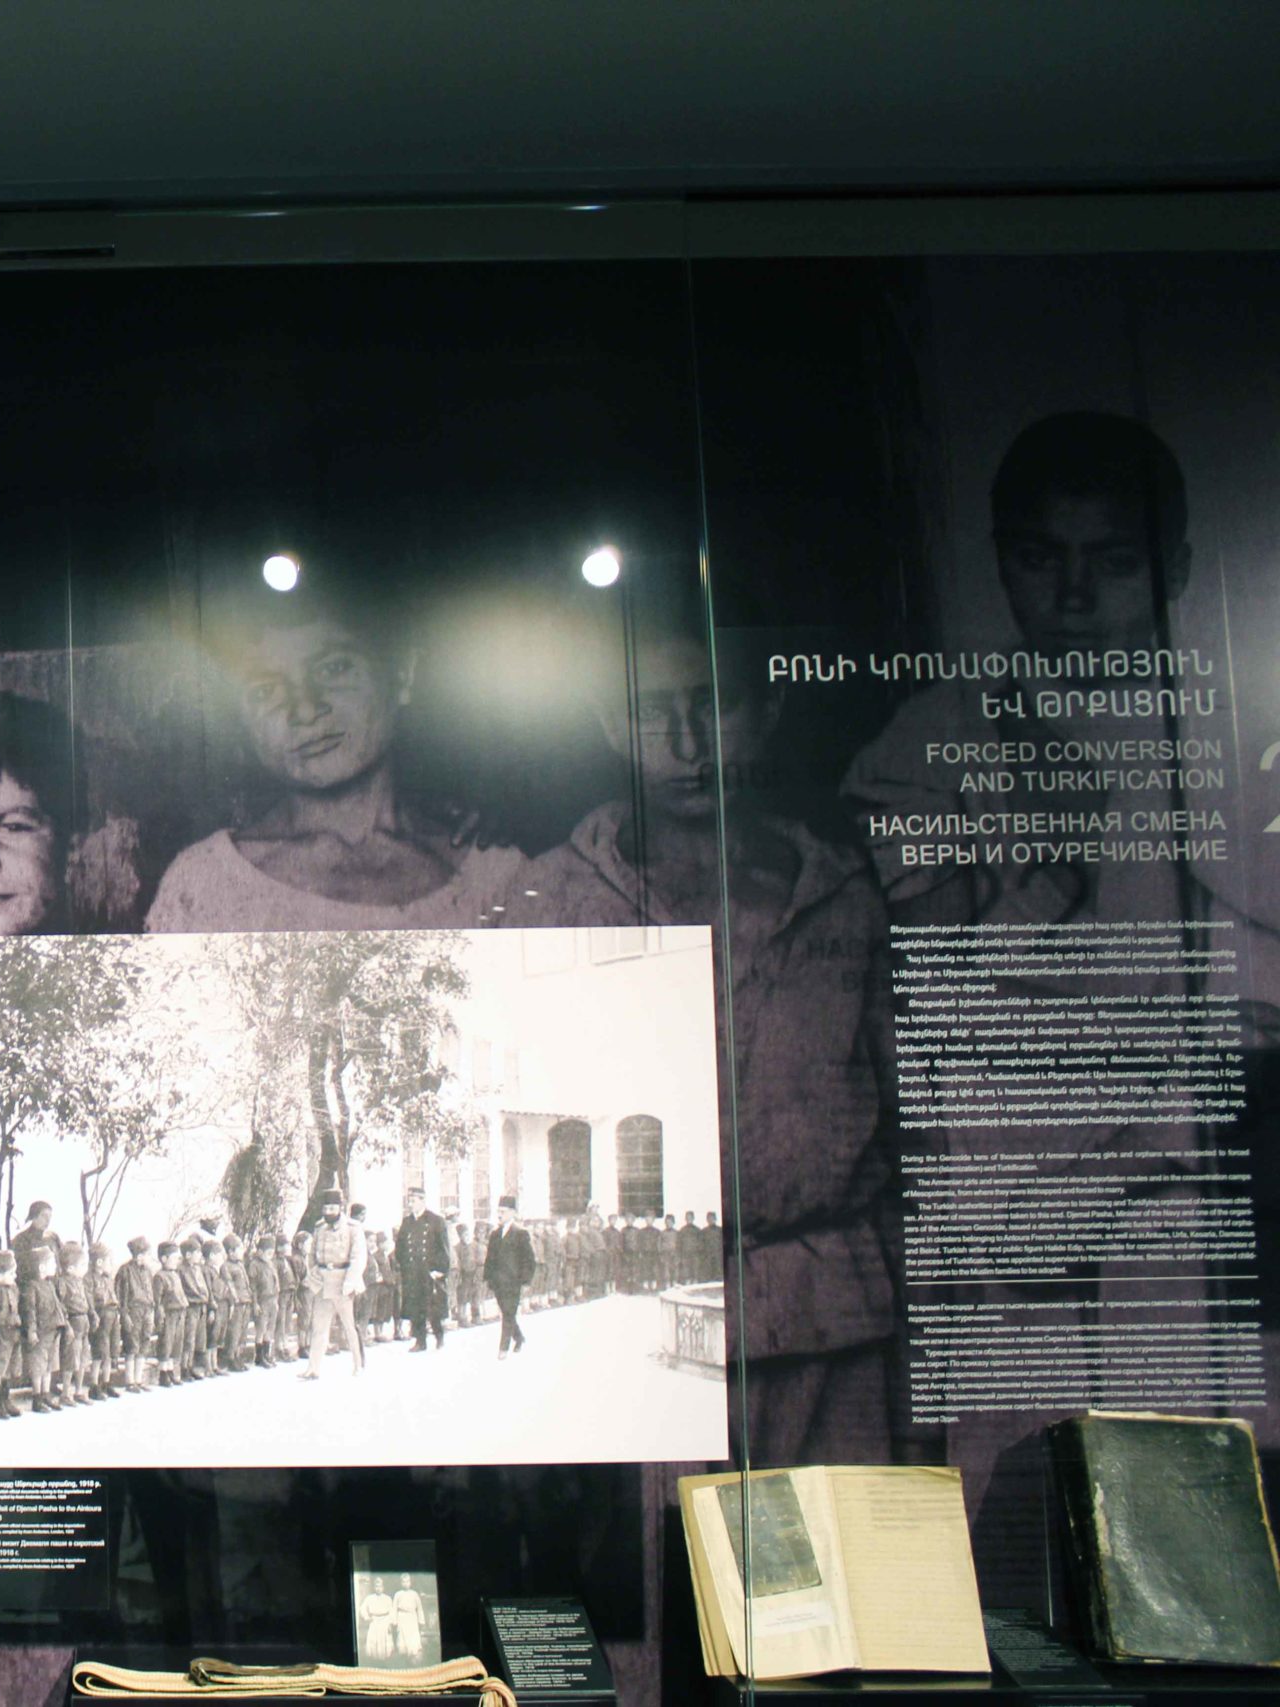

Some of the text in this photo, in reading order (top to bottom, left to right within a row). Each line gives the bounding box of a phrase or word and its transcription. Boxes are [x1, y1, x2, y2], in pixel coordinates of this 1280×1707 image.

[768, 648, 1213, 682] ԲՌՆԻ ԿՐՈՆԱՓՈԽՈՒԹՅՈՒՆ
[981, 688, 1217, 719] ԵՎ ԹՐՔԱՑՈՒՄ
[925, 739, 1222, 764] FORCED CONVERSION
[960, 768, 1224, 793] AND TURKIFICATION
[869, 810, 1226, 837] НАСИЛЬСТВЕННАЯ СМЕНА
[902, 840, 1228, 866] ВЕРЫ И ОТУРЕЧИВАНИЕ
[901, 1155, 923, 1165] During
[926, 1154, 936, 1162] the
[939, 1154, 971, 1162] Genocide
[973, 1153, 988, 1162] tens
[990, 1153, 997, 1161] of
[1000, 1152, 1034, 1161] thousands
[1036, 1152, 1043, 1160] of
[1046, 1152, 1077, 1160] Armenian
[1080, 1153, 1100, 1161] young
[1103, 1151, 1116, 1161] girls
[1120, 1151, 1132, 1159] and
[1135, 1150, 1162, 1160] orphans
[1184, 1149, 1216, 1159] subjected
[1218, 1149, 1224, 1157] to
[1227, 1148, 1249, 1157] forced
[902, 1165, 937, 1174] conversion
[983, 1164, 996, 1172] and
[917, 1178, 930, 1187] The
[931, 1178, 962, 1186] Armenian
[964, 1178, 977, 1188] girls
[979, 1177, 992, 1186] and
[1069, 1176, 1087, 1186] along
[1088, 1175, 1124, 1185] deportation
[1127, 1175, 1147, 1183] routes
[1149, 1174, 1161, 1182] and
[1163, 1174, 1168, 1182] in
[1171, 1174, 1180, 1182] the
[1183, 1173, 1226, 1182] concentration
[1229, 1174, 1251, 1183] camps
[903, 1190, 909, 1198] of
[957, 1189, 973, 1197] from
[973, 1188, 994, 1197] where
[994, 1188, 1009, 1198] they
[1026, 1187, 1062, 1198] kidnapped
[1062, 1187, 1075, 1195] and
[1075, 1186, 1097, 1195] forced
[1097, 1186, 1104, 1194] to
[919, 1203, 931, 1211] The
[933, 1202, 956, 1211] Turkish
[958, 1202, 992, 1210] authorities
[993, 1201, 1007, 1211] paid
[1009, 1201, 1038, 1211] particular
[1041, 1200, 1069, 1209] attention
[1071, 1200, 1076, 1208] to
[1113, 1199, 1125, 1207] and
[1127, 1198, 1159, 1209] Turkifying
[1193, 1198, 1200, 1206] of
[1201, 1197, 1232, 1206] Armenian
[924, 1213, 948, 1222] number
[950, 1213, 957, 1221] of
[1010, 1212, 1028, 1220] taken
[1029, 1212, 1036, 1220] to
[1037, 1211, 1049, 1220] this
[1115, 1210, 1141, 1218] Minister
[1143, 1210, 1149, 1218] of
[1151, 1209, 1161, 1218] the
[1181, 1209, 1194, 1217] and
[1210, 1208, 1215, 1216] of
[1217, 1208, 1227, 1216] the
[920, 1225, 926, 1233] of
[928, 1225, 938, 1233] the
[940, 1224, 971, 1232] Armenian
[1008, 1223, 1030, 1231] issued
[1038, 1222, 1065, 1231] directive
[1112, 1221, 1131, 1231] public
[1133, 1220, 1151, 1229] funds
[1153, 1220, 1161, 1228] for
[1164, 1220, 1174, 1228] the
[1176, 1219, 1221, 1228] establishment
[1224, 1219, 1229, 1227] of
